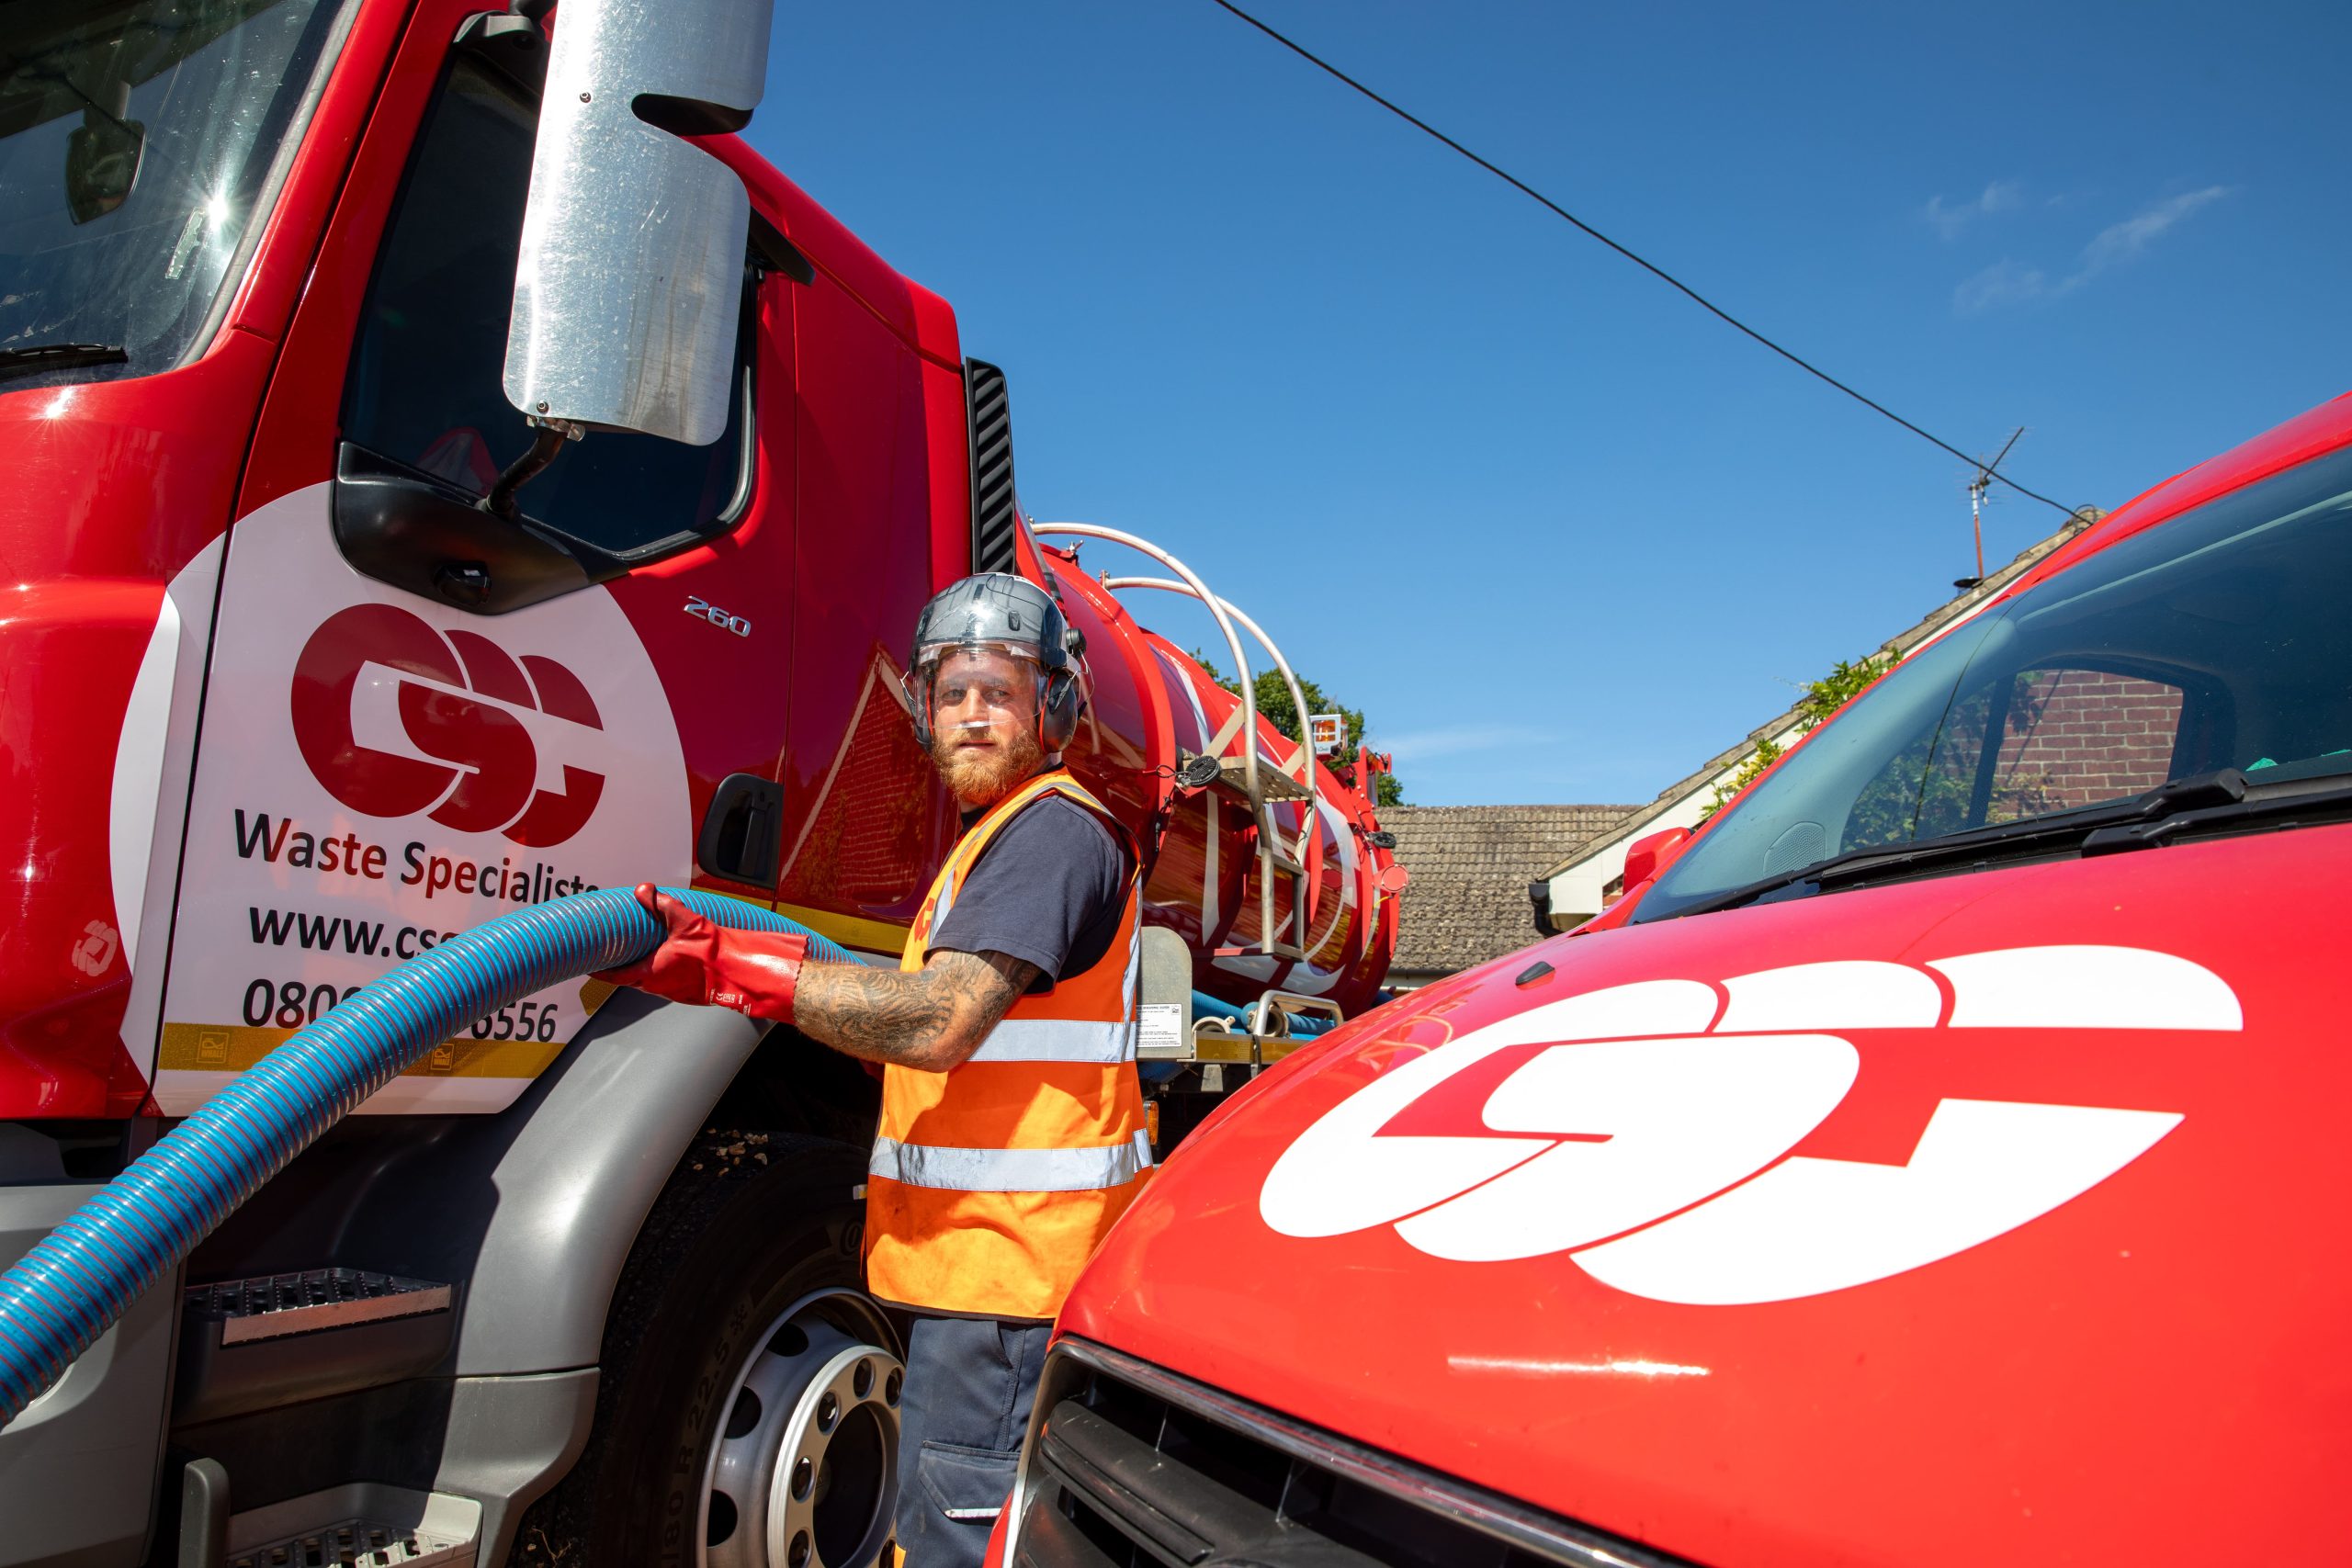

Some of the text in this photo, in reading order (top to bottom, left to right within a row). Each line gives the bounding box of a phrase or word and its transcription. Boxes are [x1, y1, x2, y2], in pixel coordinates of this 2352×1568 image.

[684, 595, 752, 637] 260
[235, 808, 600, 905] Waste Specialist
[243, 978, 362, 1029] 080
